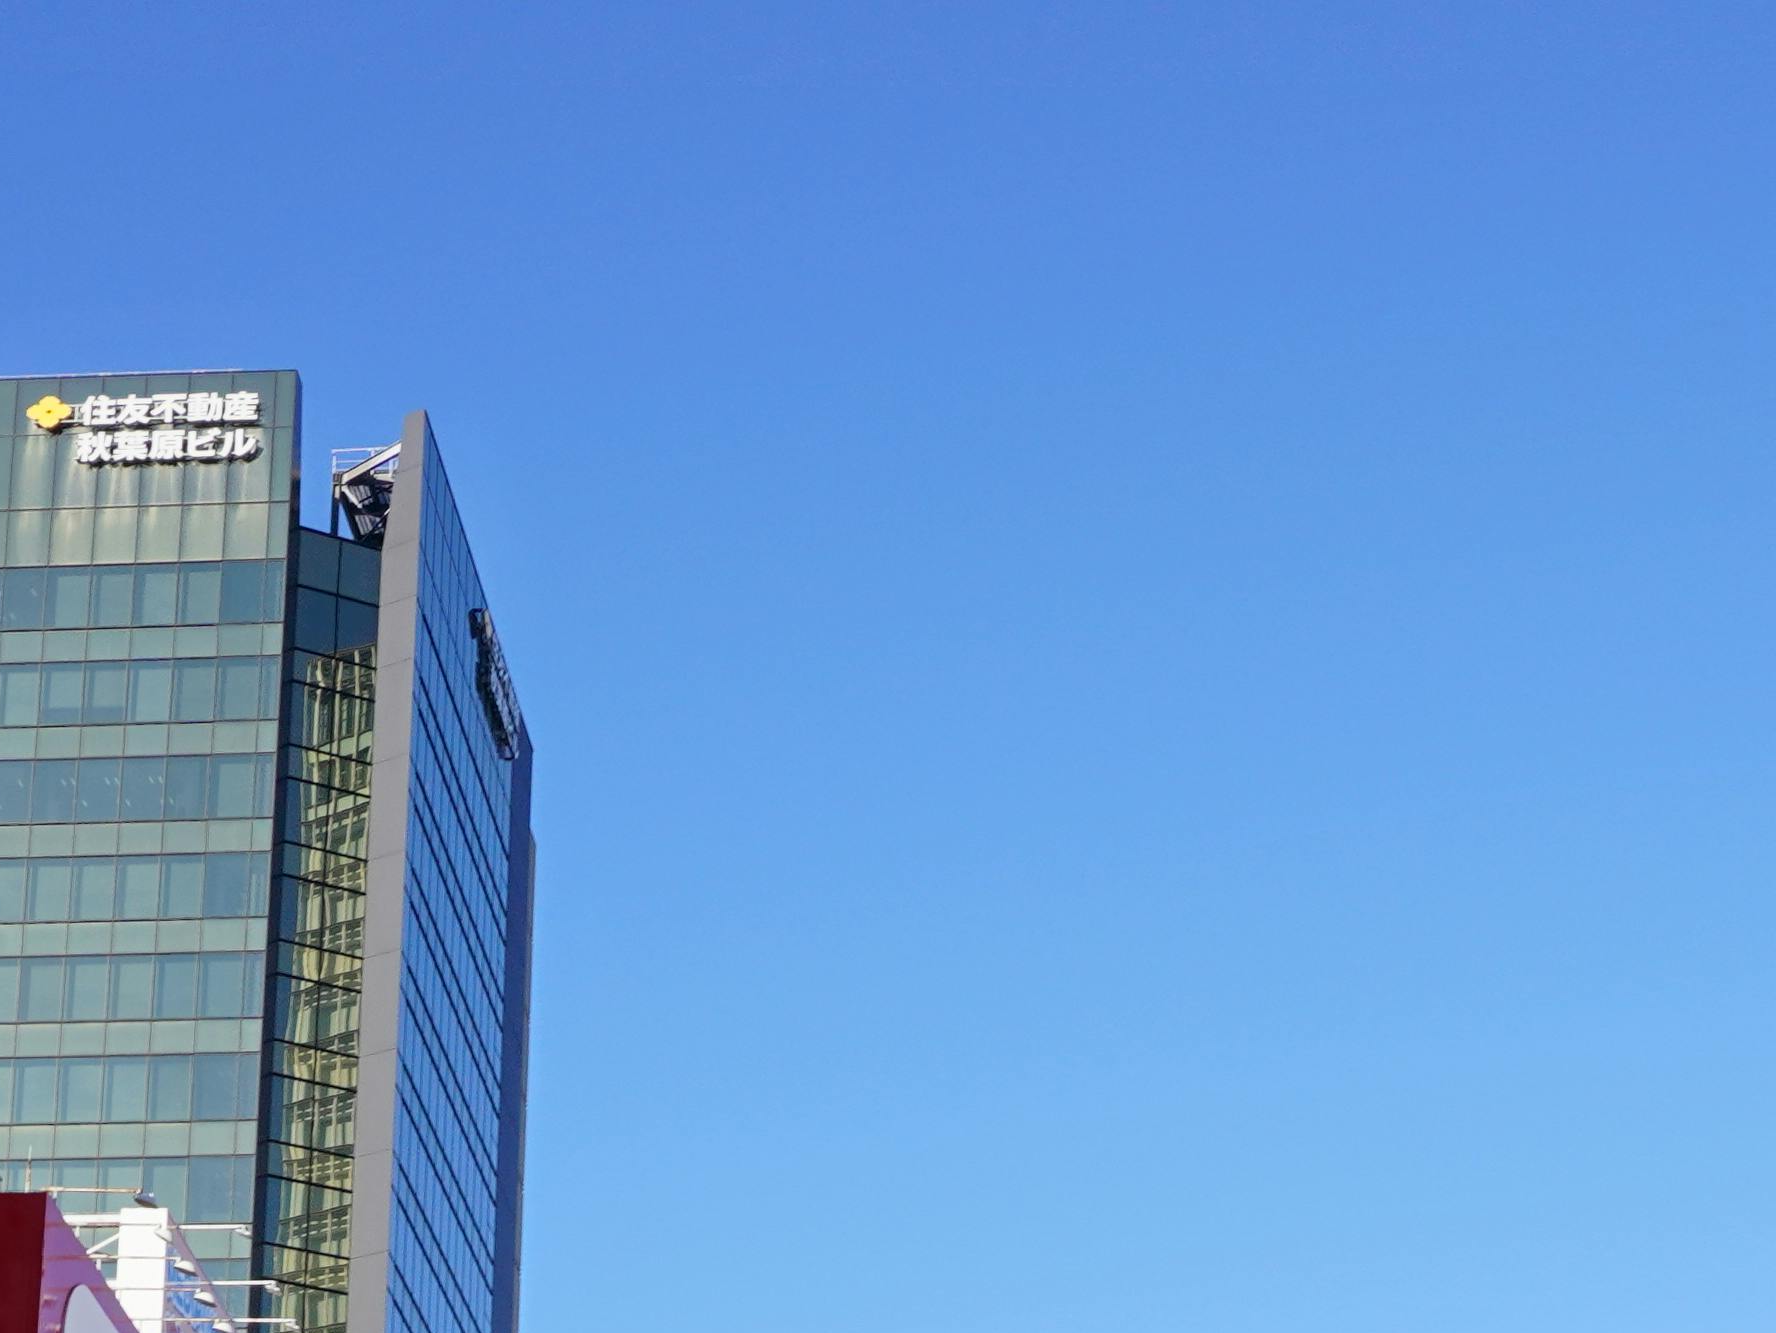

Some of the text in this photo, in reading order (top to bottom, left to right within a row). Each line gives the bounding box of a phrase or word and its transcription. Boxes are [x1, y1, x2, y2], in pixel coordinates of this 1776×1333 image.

[81, 391, 259, 426] 住友不動産
[75, 428, 258, 462] 秋葉原ビル
